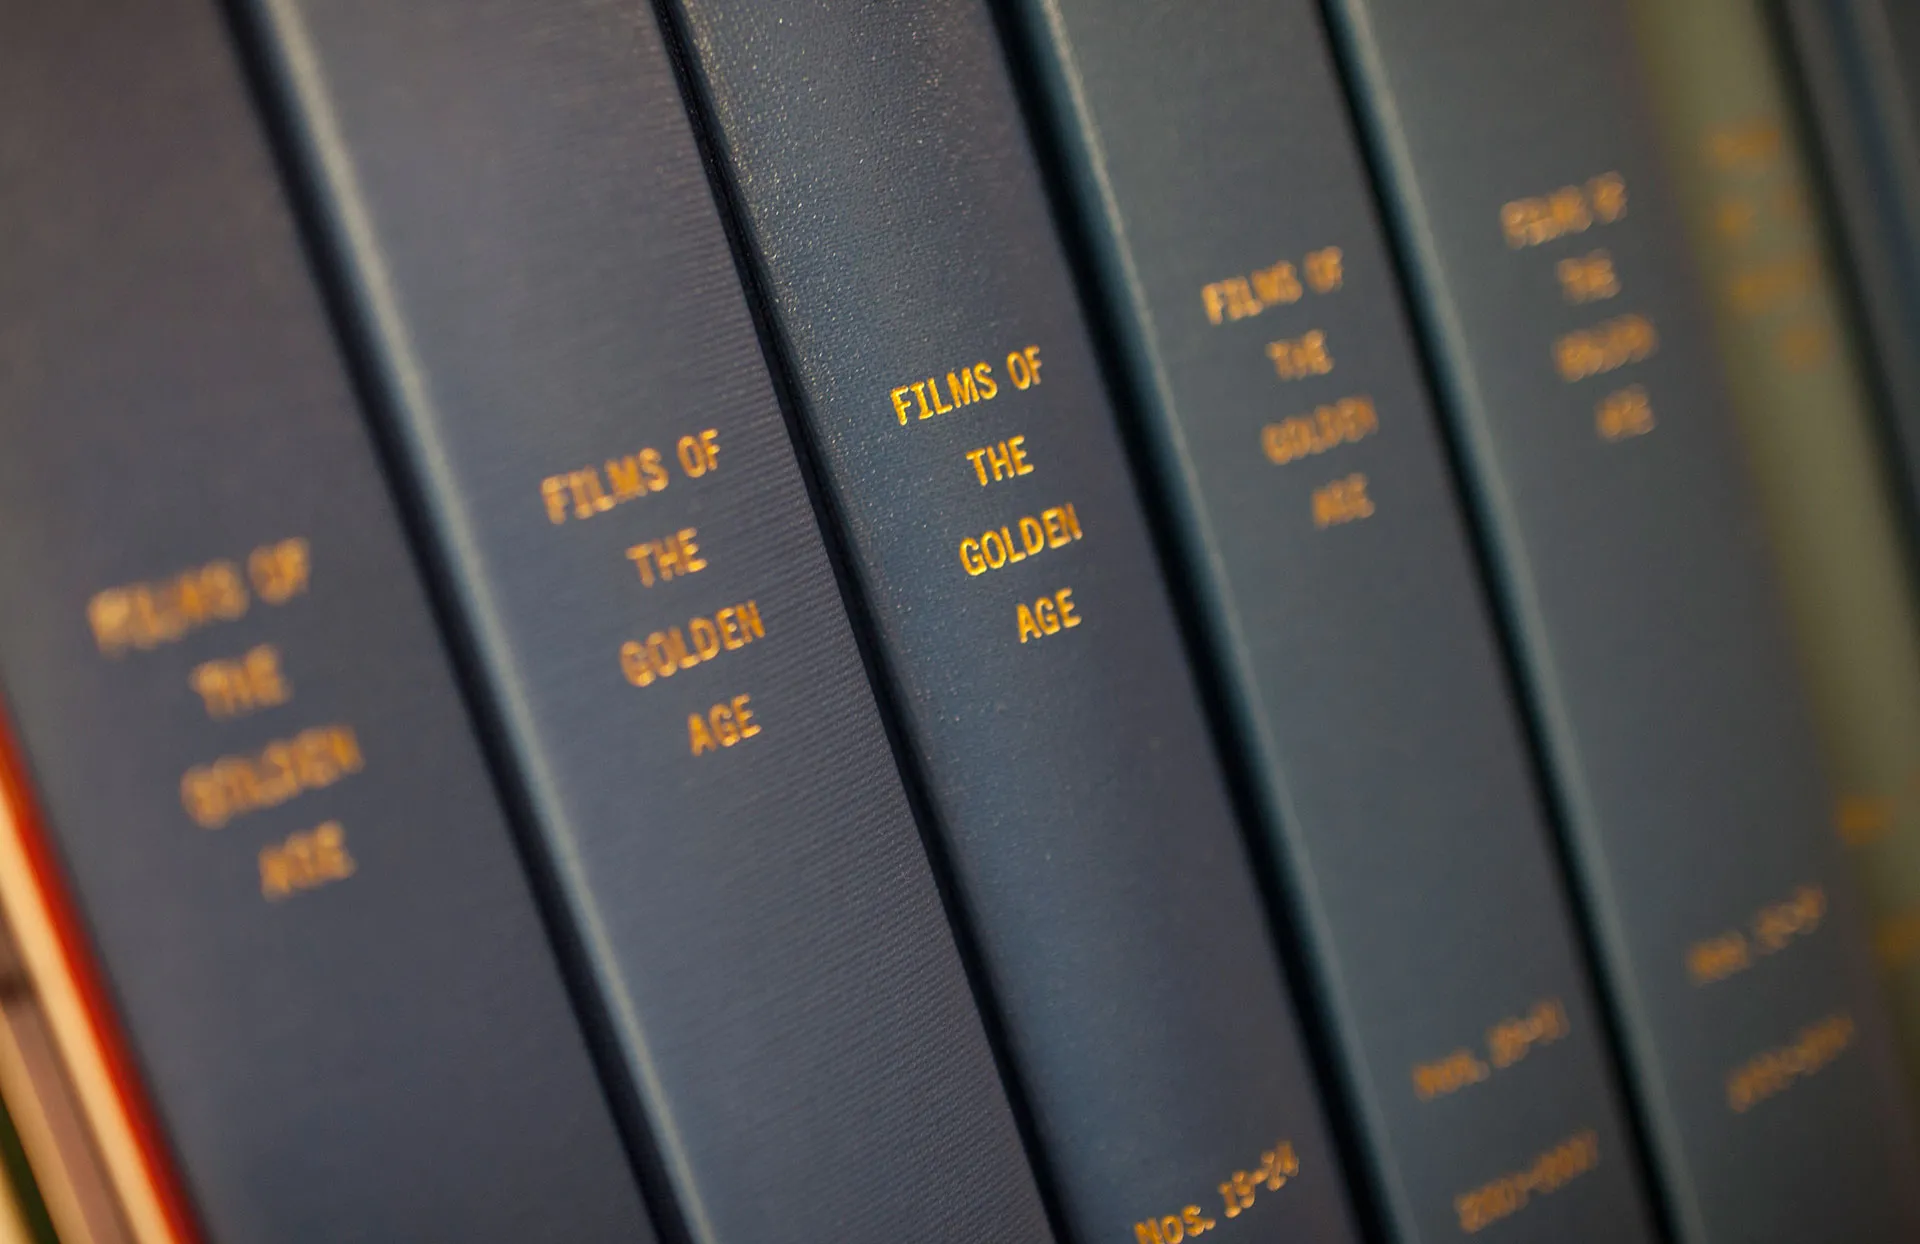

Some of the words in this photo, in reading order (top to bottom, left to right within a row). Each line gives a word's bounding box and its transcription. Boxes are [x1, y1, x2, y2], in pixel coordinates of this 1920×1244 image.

[890, 361, 998, 426] FILMS
[1006, 344, 1042, 390] OF
[540, 447, 669, 524] FILMS
[676, 427, 720, 478] OF
[965, 434, 1034, 487] THE
[625, 527, 707, 587] THE
[959, 503, 1083, 576] GOLDEN
[620, 600, 765, 687] GOLDEN
[1016, 587, 1081, 644] AGE
[688, 693, 761, 756] AGE
